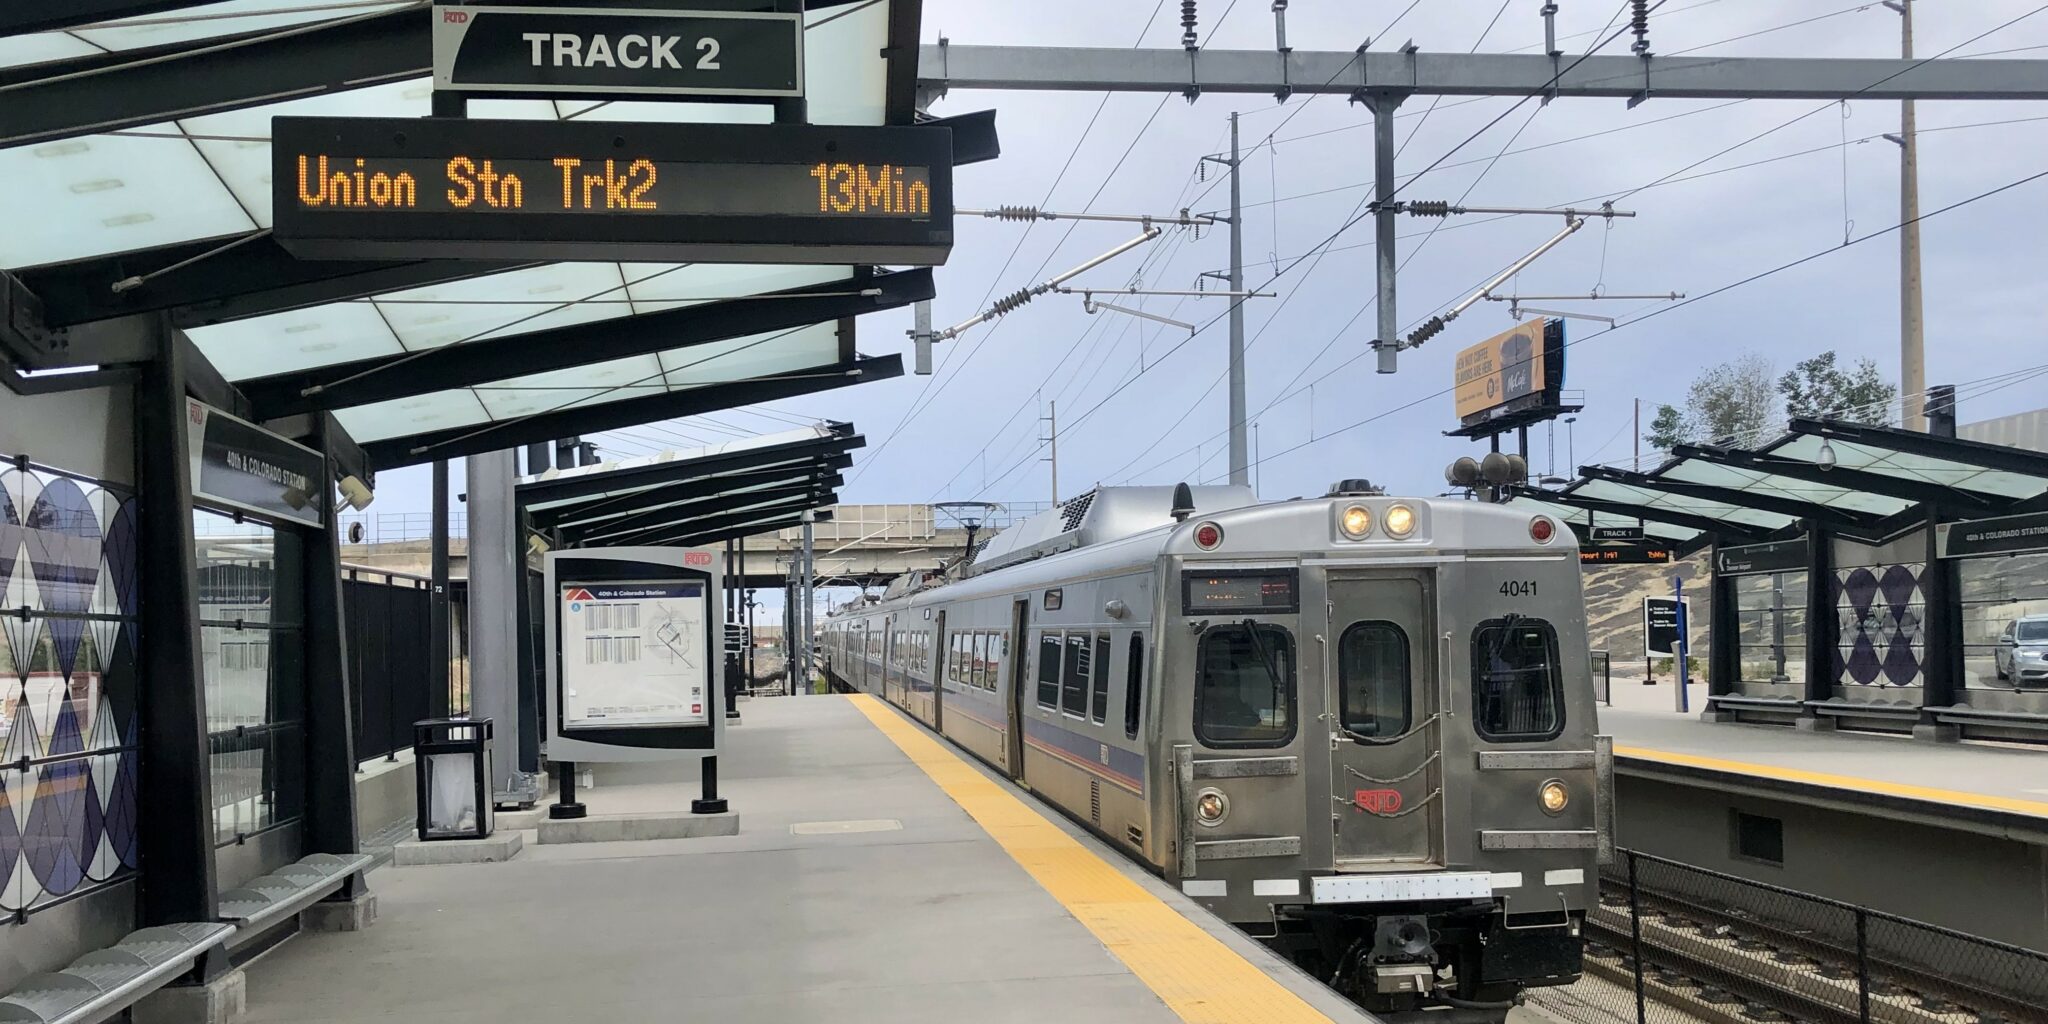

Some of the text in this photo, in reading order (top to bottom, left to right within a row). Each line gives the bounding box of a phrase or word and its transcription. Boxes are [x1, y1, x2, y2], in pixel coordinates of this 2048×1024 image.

[523, 33, 720, 70] TRACK 2
[299, 154, 929, 214] Union Stn Trk2 13Min
[227, 450, 306, 491] 40th & COLORADO STATION
[1985, 528, 2020, 540] COLORADO
[2021, 525, 2048, 536] STATION
[684, 552, 713, 565] RTD
[435, 585, 443, 593] 72
[1499, 580, 1537, 597] 4041
[1355, 789, 1402, 815] RTD
